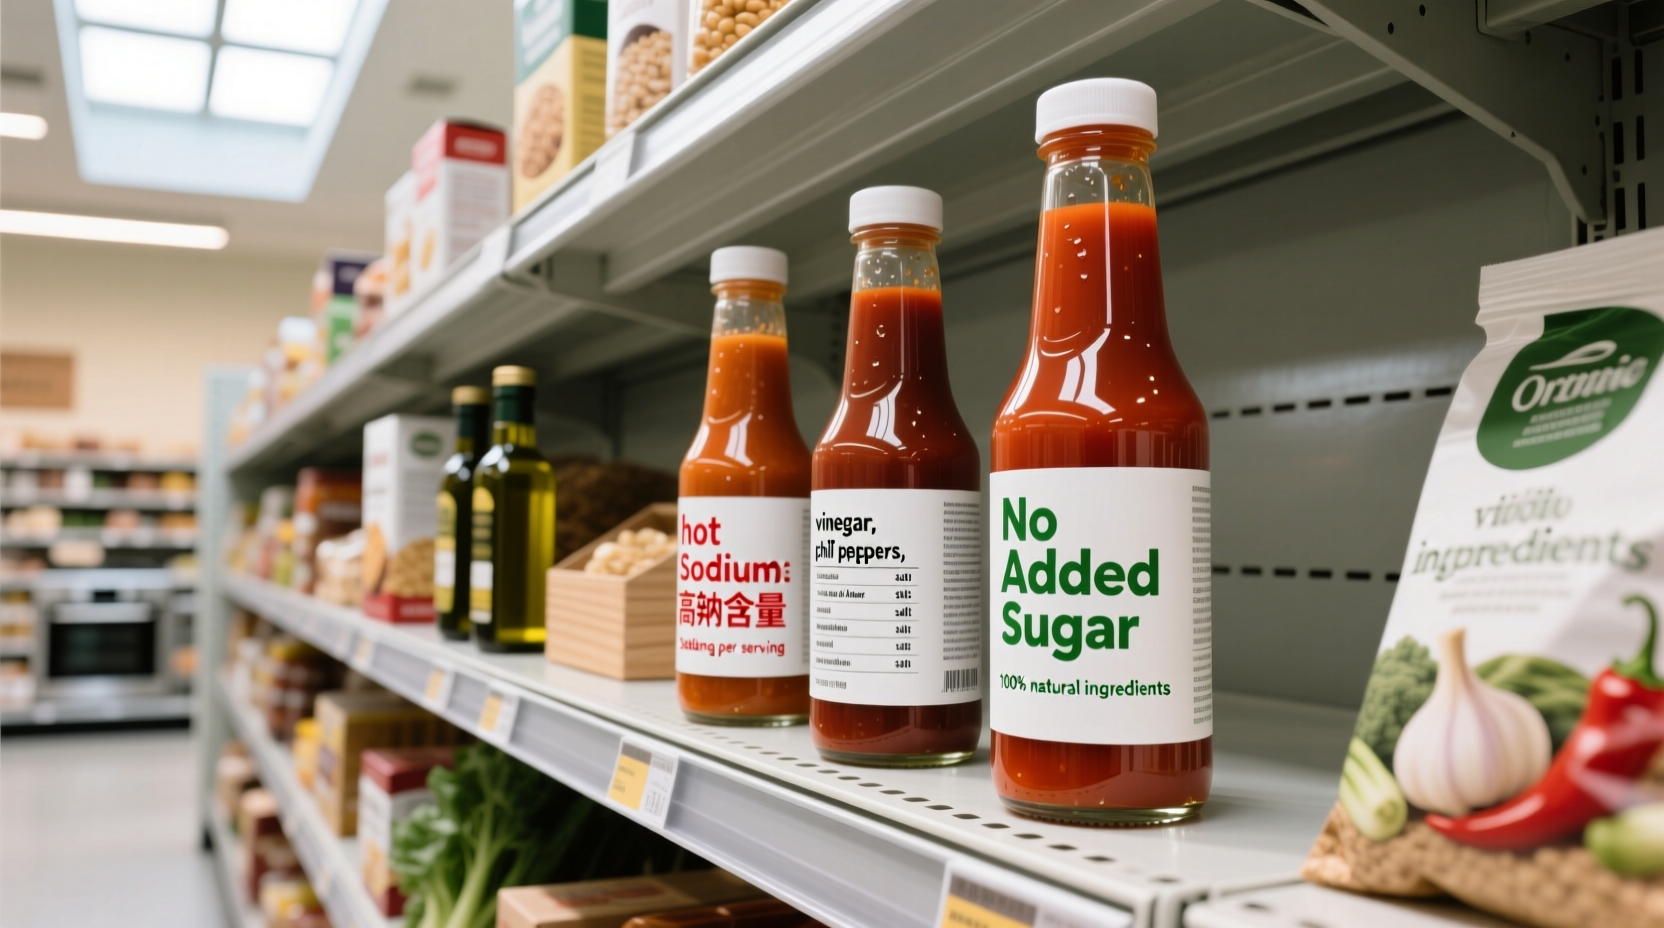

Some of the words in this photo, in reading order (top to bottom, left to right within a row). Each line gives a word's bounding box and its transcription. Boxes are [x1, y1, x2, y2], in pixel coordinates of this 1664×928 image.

[682, 513, 721, 546] hot
[815, 511, 876, 537] vinegar,
[1002, 496, 1058, 542] No
[1001, 548, 1159, 596] Added
[1002, 601, 1140, 662] Sugar
[718, 643, 737, 657] per
[1000, 673, 1027, 691] 100%
[1030, 678, 1080, 695] natural
[1085, 679, 1171, 699] ingredients
